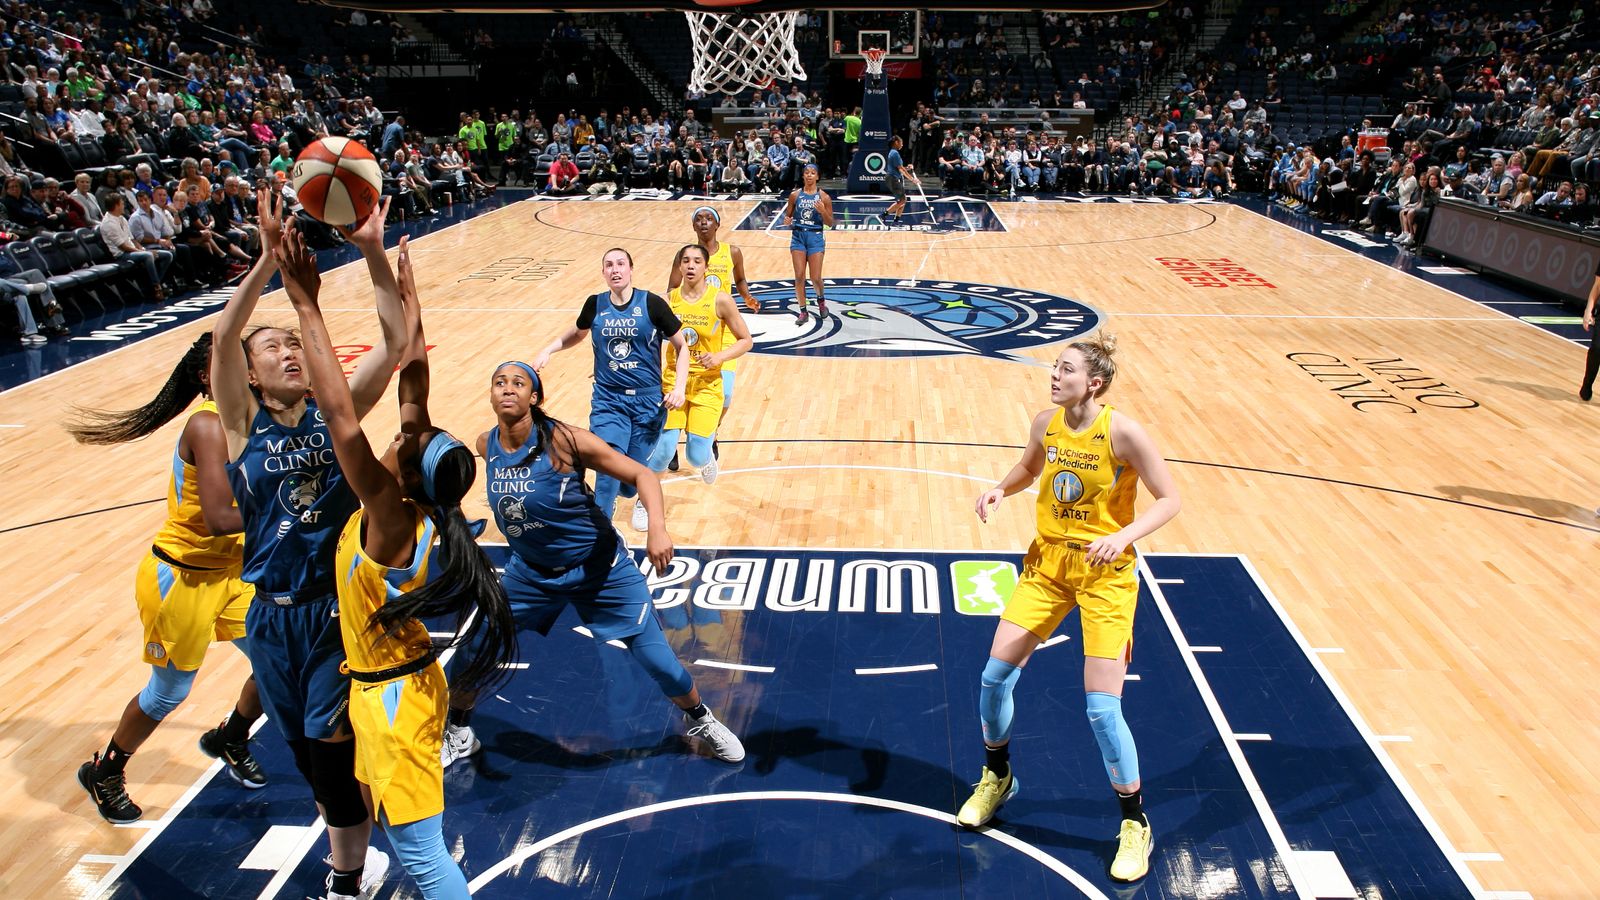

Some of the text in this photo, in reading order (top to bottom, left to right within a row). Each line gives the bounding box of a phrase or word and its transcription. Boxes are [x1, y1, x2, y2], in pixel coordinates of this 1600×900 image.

[1155, 257, 1229, 288] CENTER
[1196, 258, 1278, 289] TARGET
[604, 318, 636, 328] MAYO
[1016, 308, 1085, 340] LYNX
[601, 327, 639, 337] CLINIC
[619, 361, 639, 370] AT&T
[1286, 352, 1418, 414] CLINIC
[1352, 356, 1480, 409] MAYO
[266, 432, 325, 454] MAYO
[264, 448, 334, 472] CLINIC
[1059, 448, 1100, 462] UChicago
[1057, 457, 1099, 471] Medicine
[494, 466, 531, 480] MAYO
[491, 480, 536, 493] CLINIC
[1060, 508, 1090, 521] AT&T
